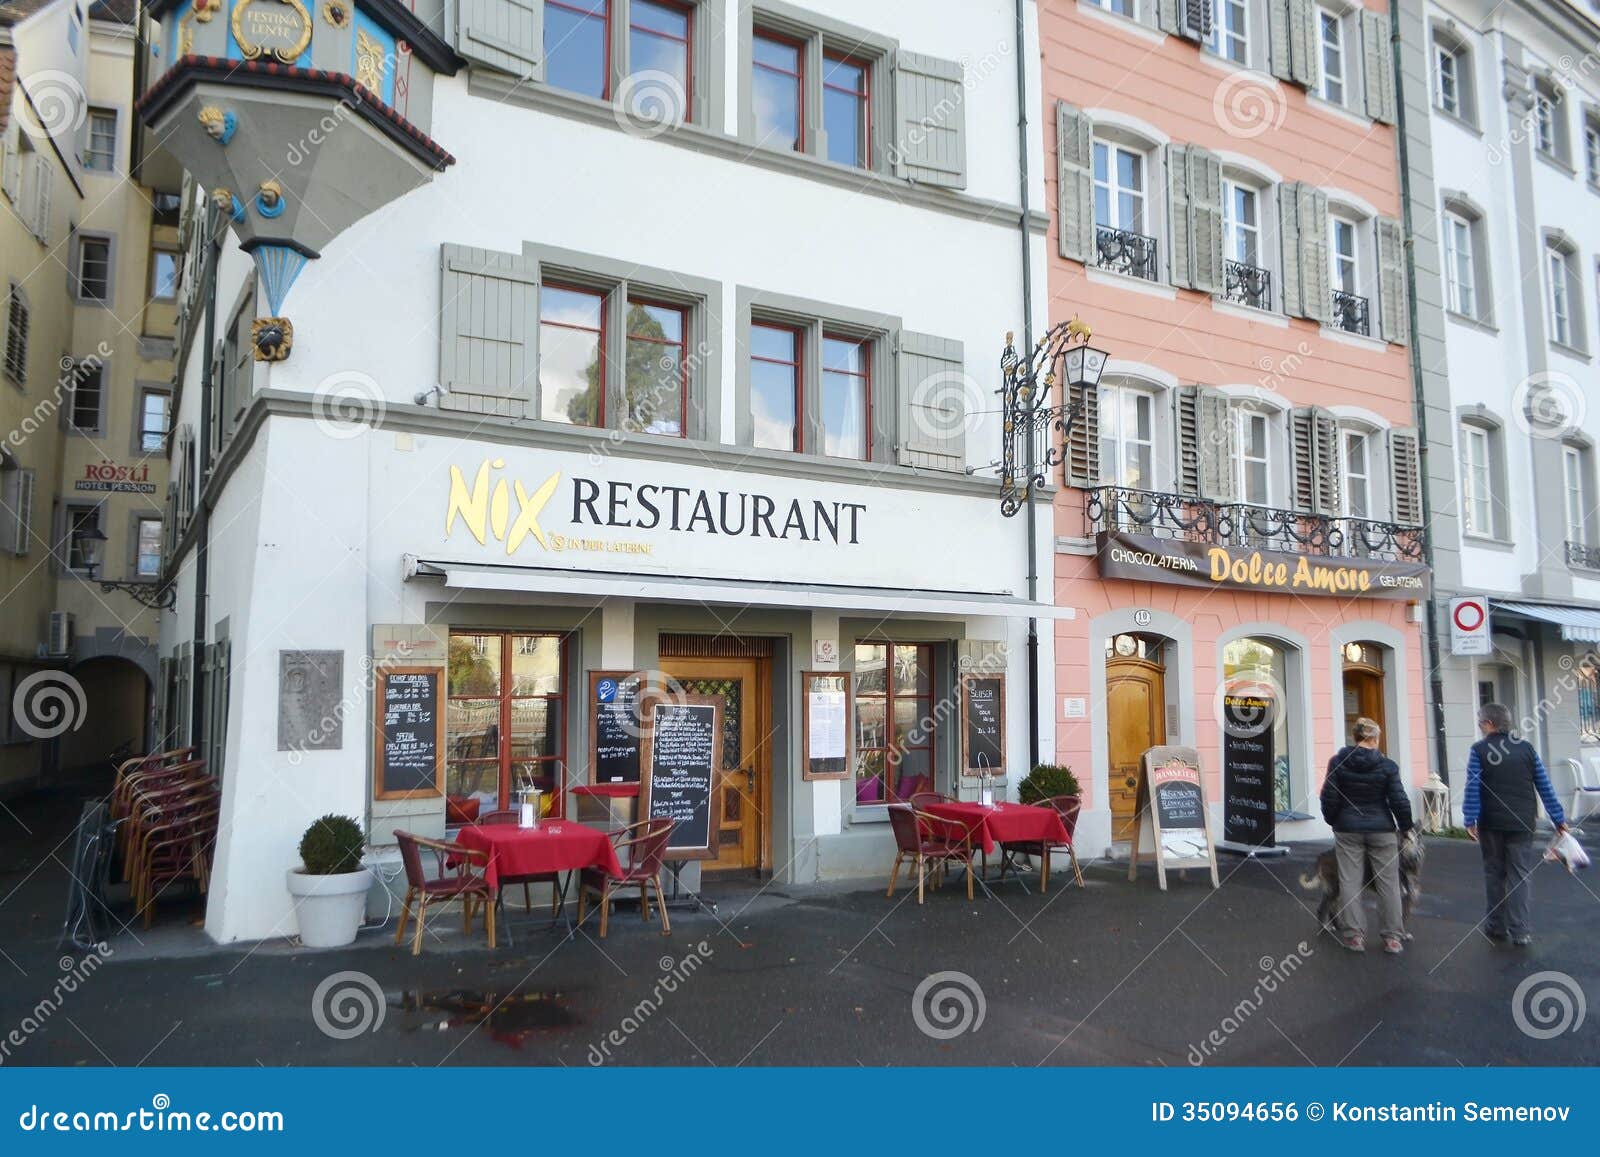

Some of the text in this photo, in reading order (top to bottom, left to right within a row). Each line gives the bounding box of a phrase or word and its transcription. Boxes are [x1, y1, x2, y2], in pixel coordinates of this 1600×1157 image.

[248, 11, 298, 28] FESTINA
[251, 23, 290, 37] LENTE
[77, 482, 154, 493] HOTEL PENSION
[570, 477, 867, 546] RESTAURANT
[1110, 548, 1423, 593] CHOCOLATERIA Dolce Amore GELATERIA
